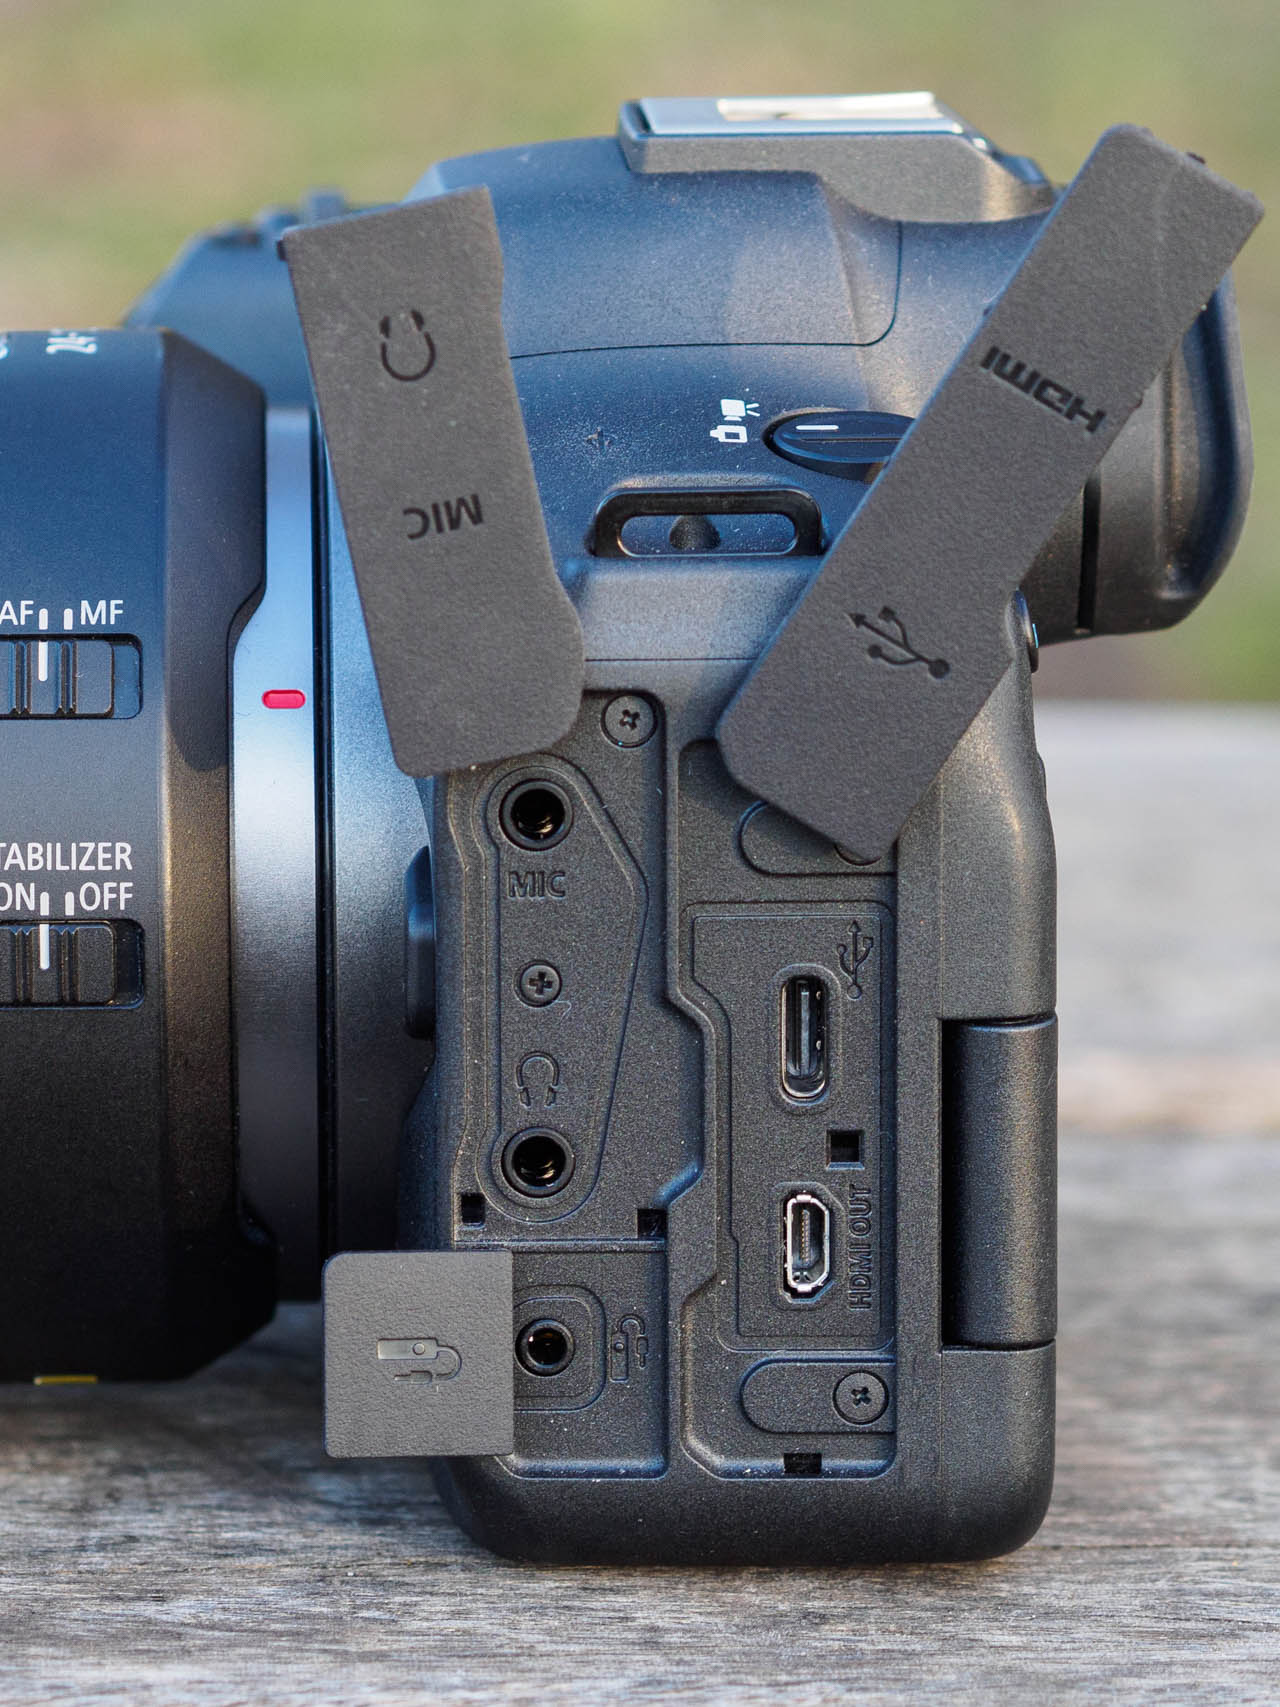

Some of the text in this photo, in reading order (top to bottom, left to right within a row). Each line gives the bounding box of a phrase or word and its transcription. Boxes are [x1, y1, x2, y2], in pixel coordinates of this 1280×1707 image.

[980, 346, 1107, 433] HDMI
[402, 493, 483, 540] MIC
[80, 599, 124, 625] MF
[79, 882, 133, 911] OFF
[506, 870, 566, 898] MIC
[848, 1183, 872, 1311] HDMI OUT
